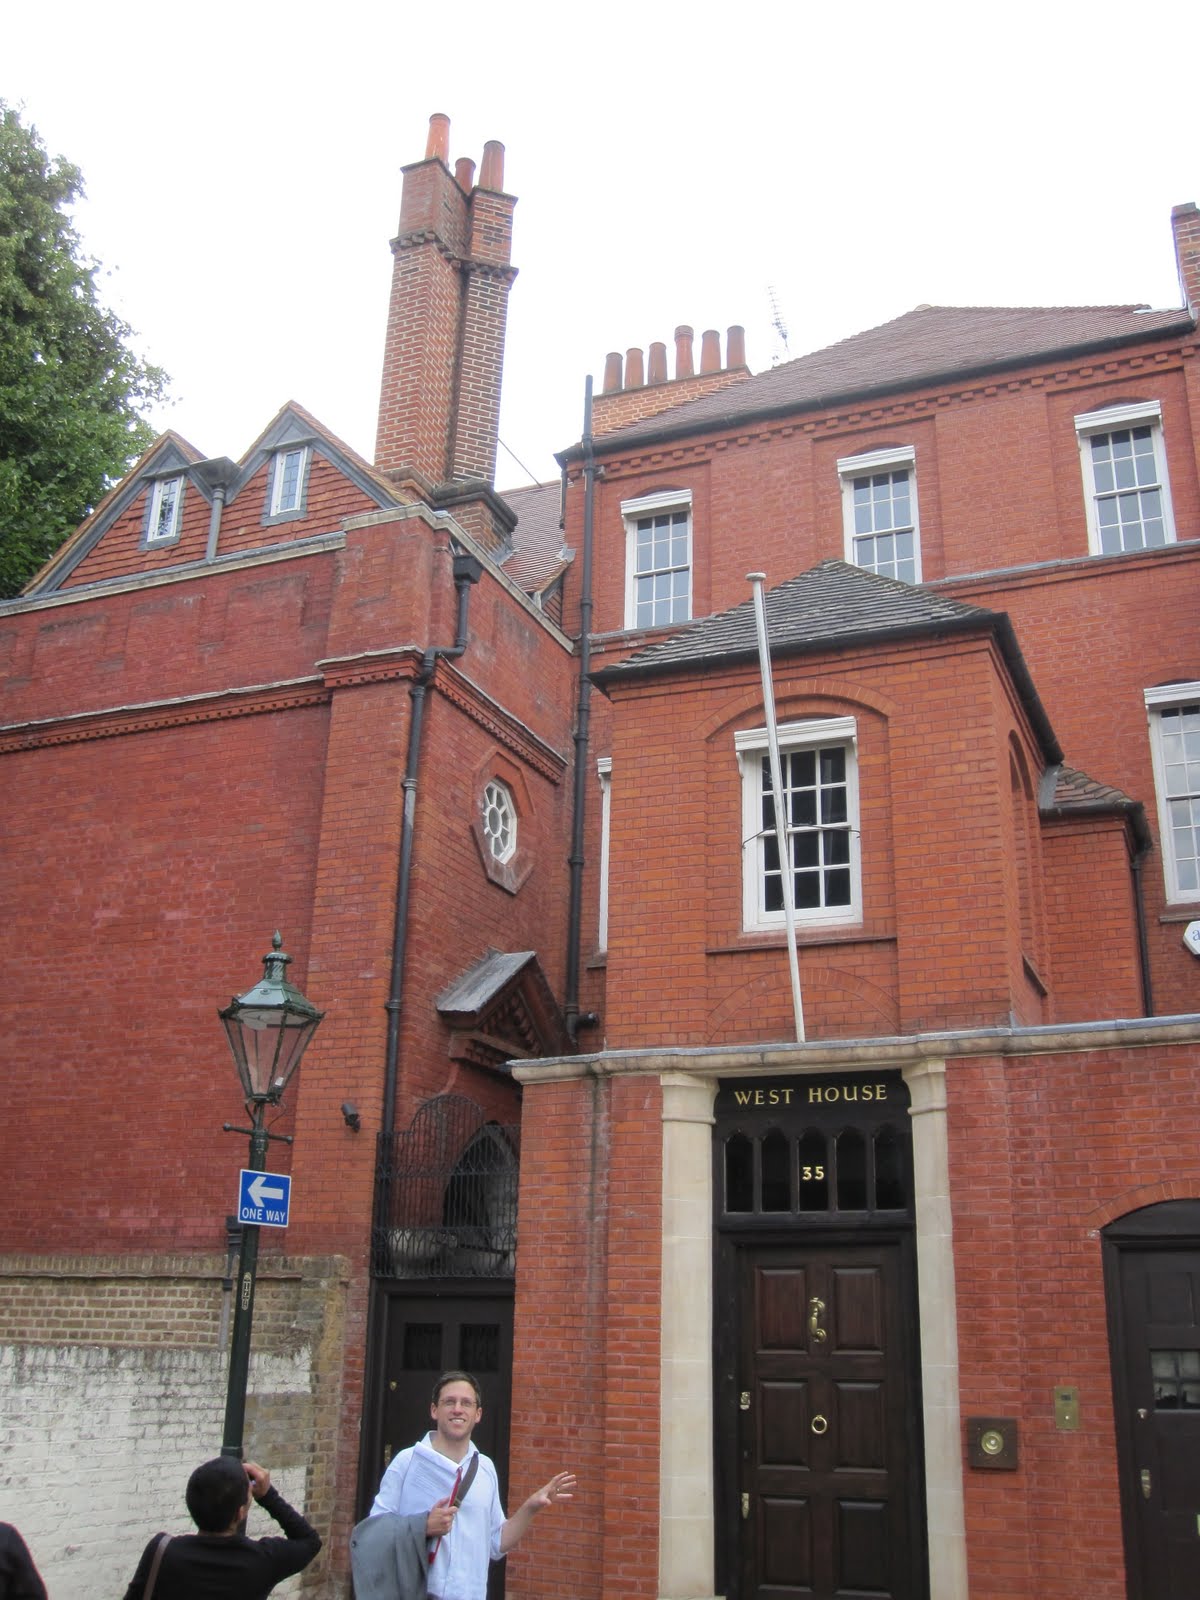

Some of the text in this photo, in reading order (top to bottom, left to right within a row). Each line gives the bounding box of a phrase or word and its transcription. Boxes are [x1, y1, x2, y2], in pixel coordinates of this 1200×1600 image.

[734, 1084, 888, 1105] WEST HOUSE
[802, 1166, 825, 1180] 35
[242, 1207, 286, 1223] ONE WAY
